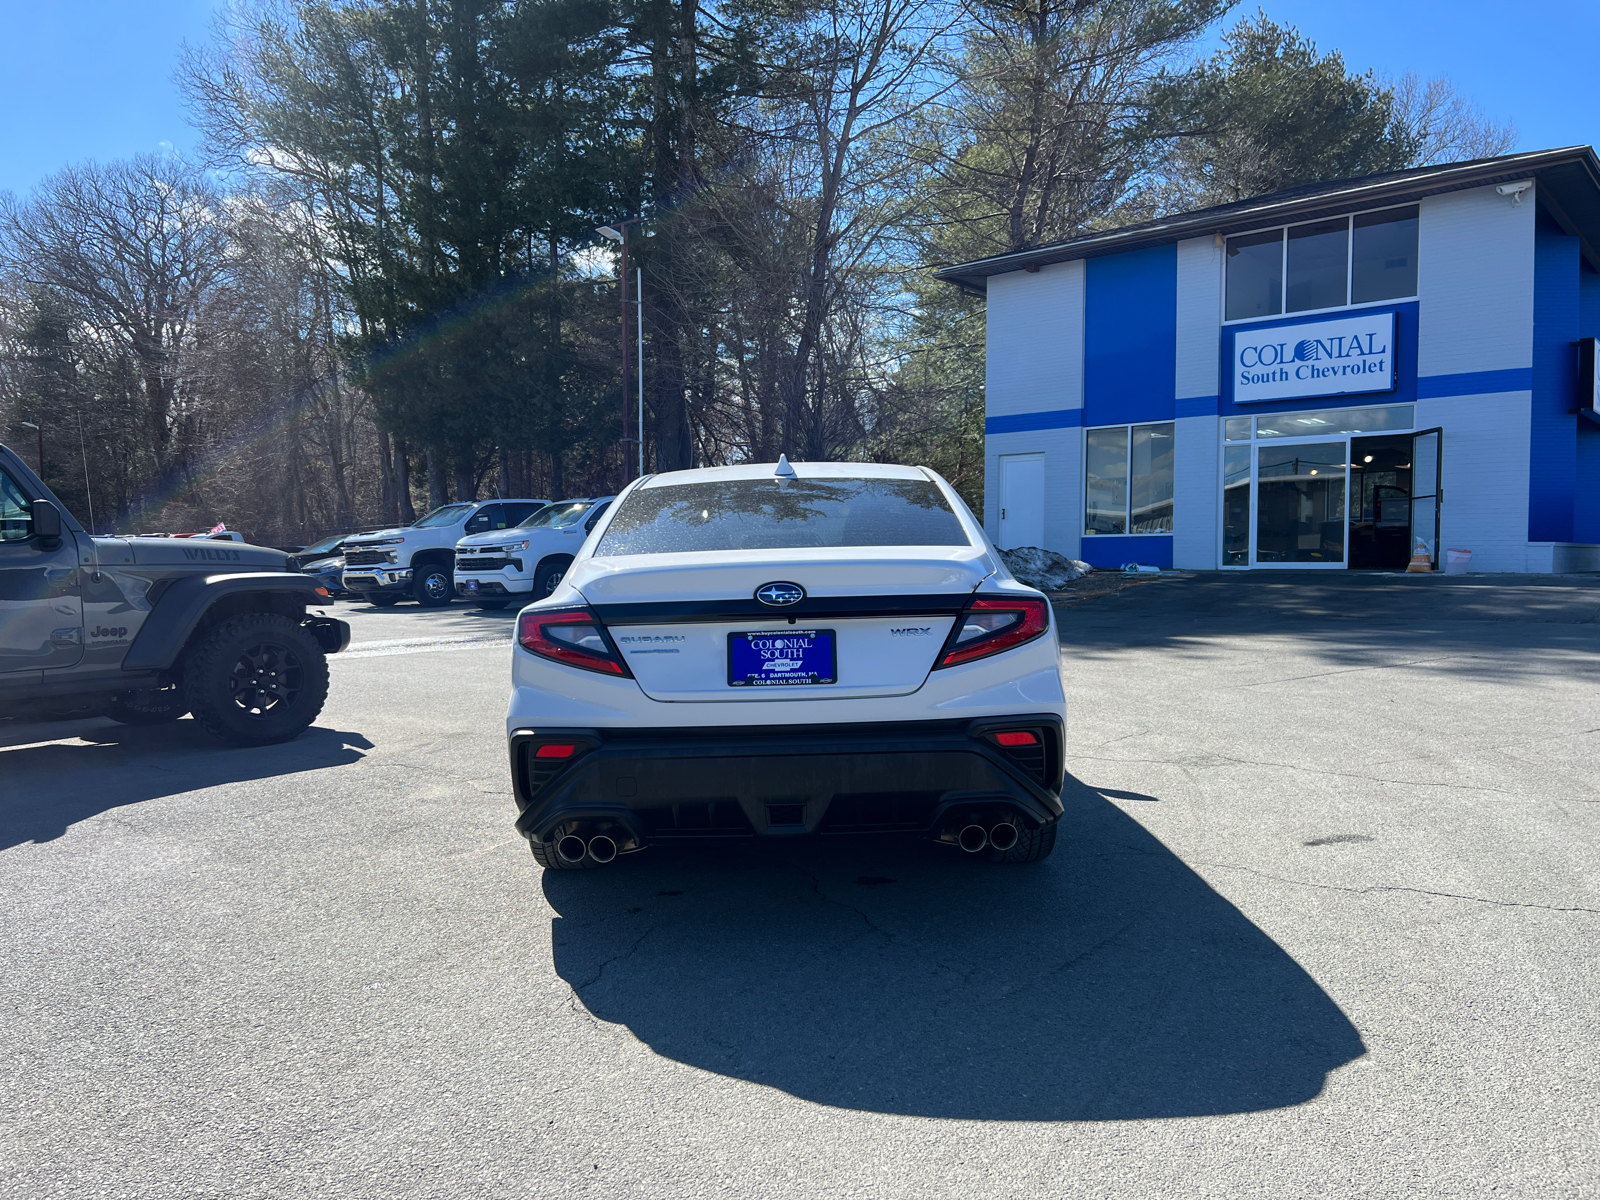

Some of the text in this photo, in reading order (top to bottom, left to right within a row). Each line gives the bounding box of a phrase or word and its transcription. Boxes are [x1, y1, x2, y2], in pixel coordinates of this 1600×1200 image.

[1240, 333, 1386, 368] COLONIAL
[1240, 358, 1386, 386] South Chevrolet
[181, 548, 241, 561] WILLYS
[90, 625, 128, 638] Jeep
[890, 627, 932, 637] WRX
[620, 635, 685, 644] SUBARU
[751, 639, 812, 650] COLONIAL
[760, 649, 804, 659] SOUTH
